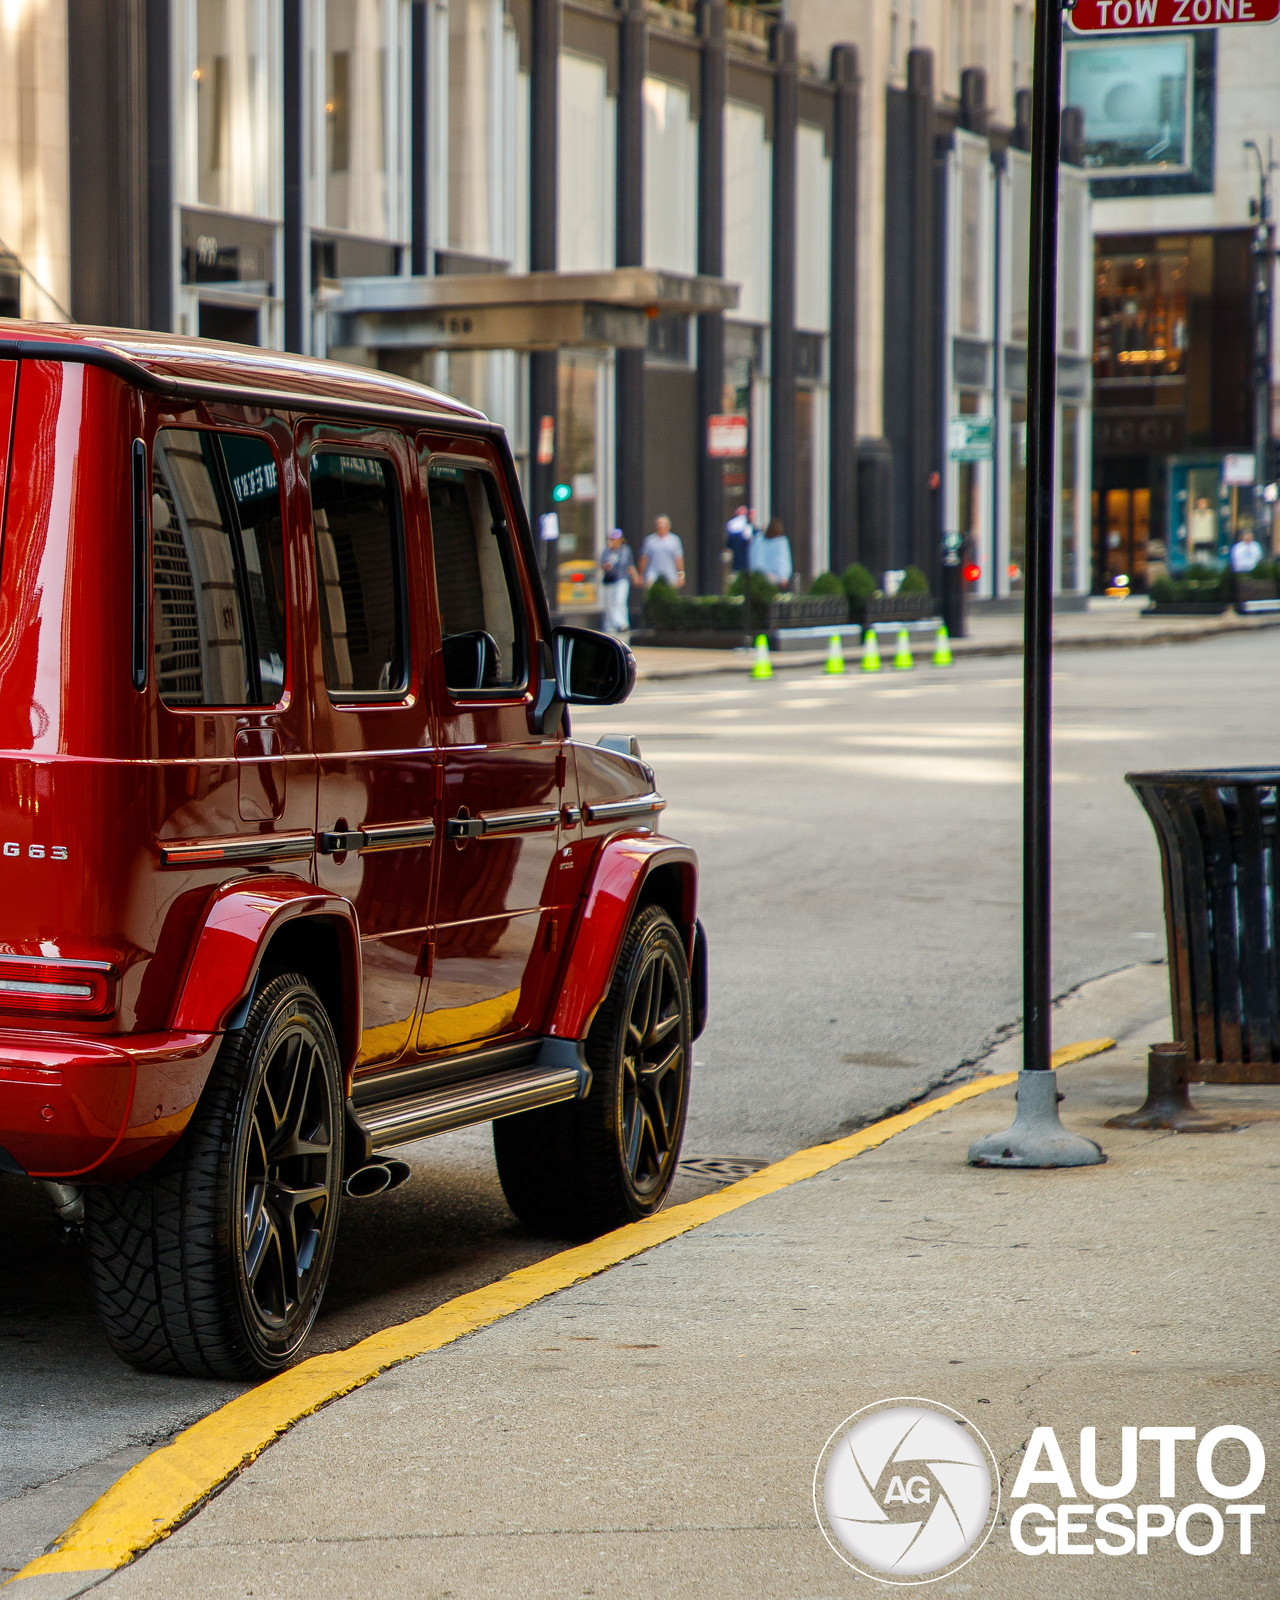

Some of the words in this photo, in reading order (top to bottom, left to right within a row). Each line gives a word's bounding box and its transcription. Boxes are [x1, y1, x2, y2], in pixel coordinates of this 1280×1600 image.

[1096, 0, 1158, 27] TOW
[1172, 0, 1256, 23] ZONE
[3, 842, 20, 857] G
[28, 844, 68, 860] 63
